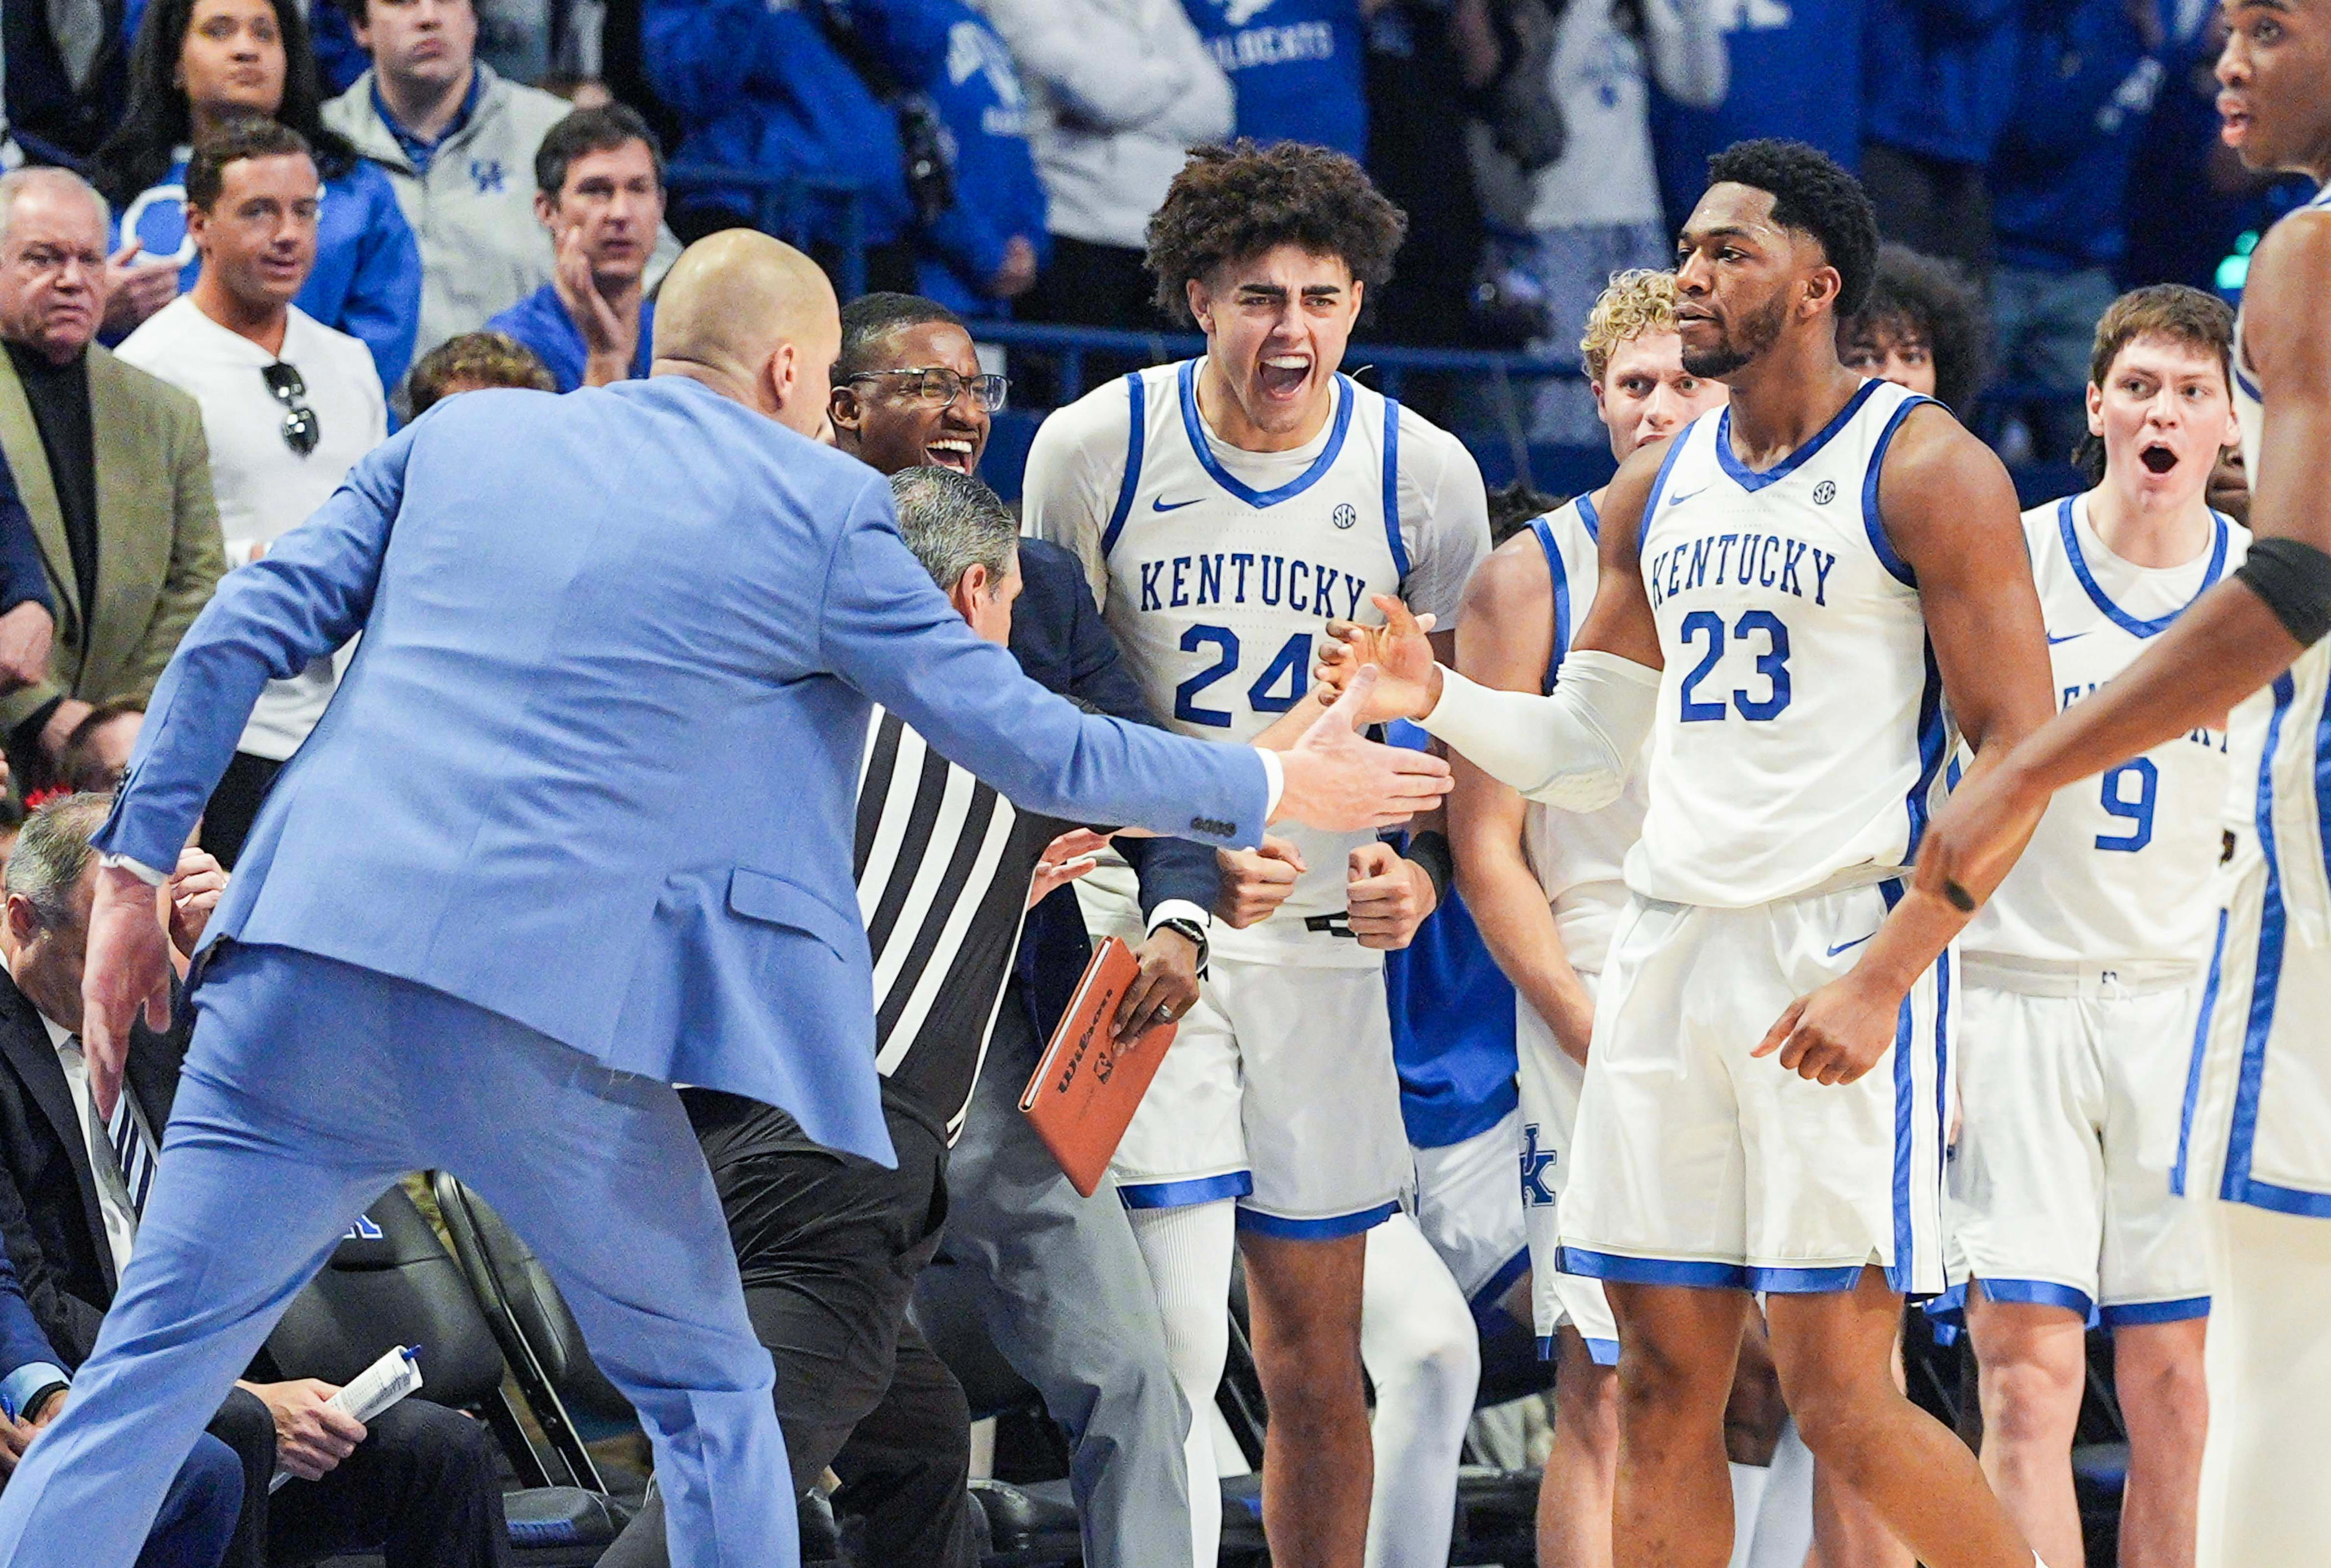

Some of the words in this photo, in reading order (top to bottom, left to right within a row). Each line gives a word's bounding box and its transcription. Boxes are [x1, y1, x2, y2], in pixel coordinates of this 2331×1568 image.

[1333, 503, 1356, 529] SEC
[1813, 480, 1836, 504] SEC
[1141, 553, 1366, 622] KENTUCKY
[1653, 533, 1836, 607] KENTUCKY
[1174, 623, 1314, 728] 24
[1680, 610, 1791, 722] 23
[2094, 756, 2158, 852] 9
